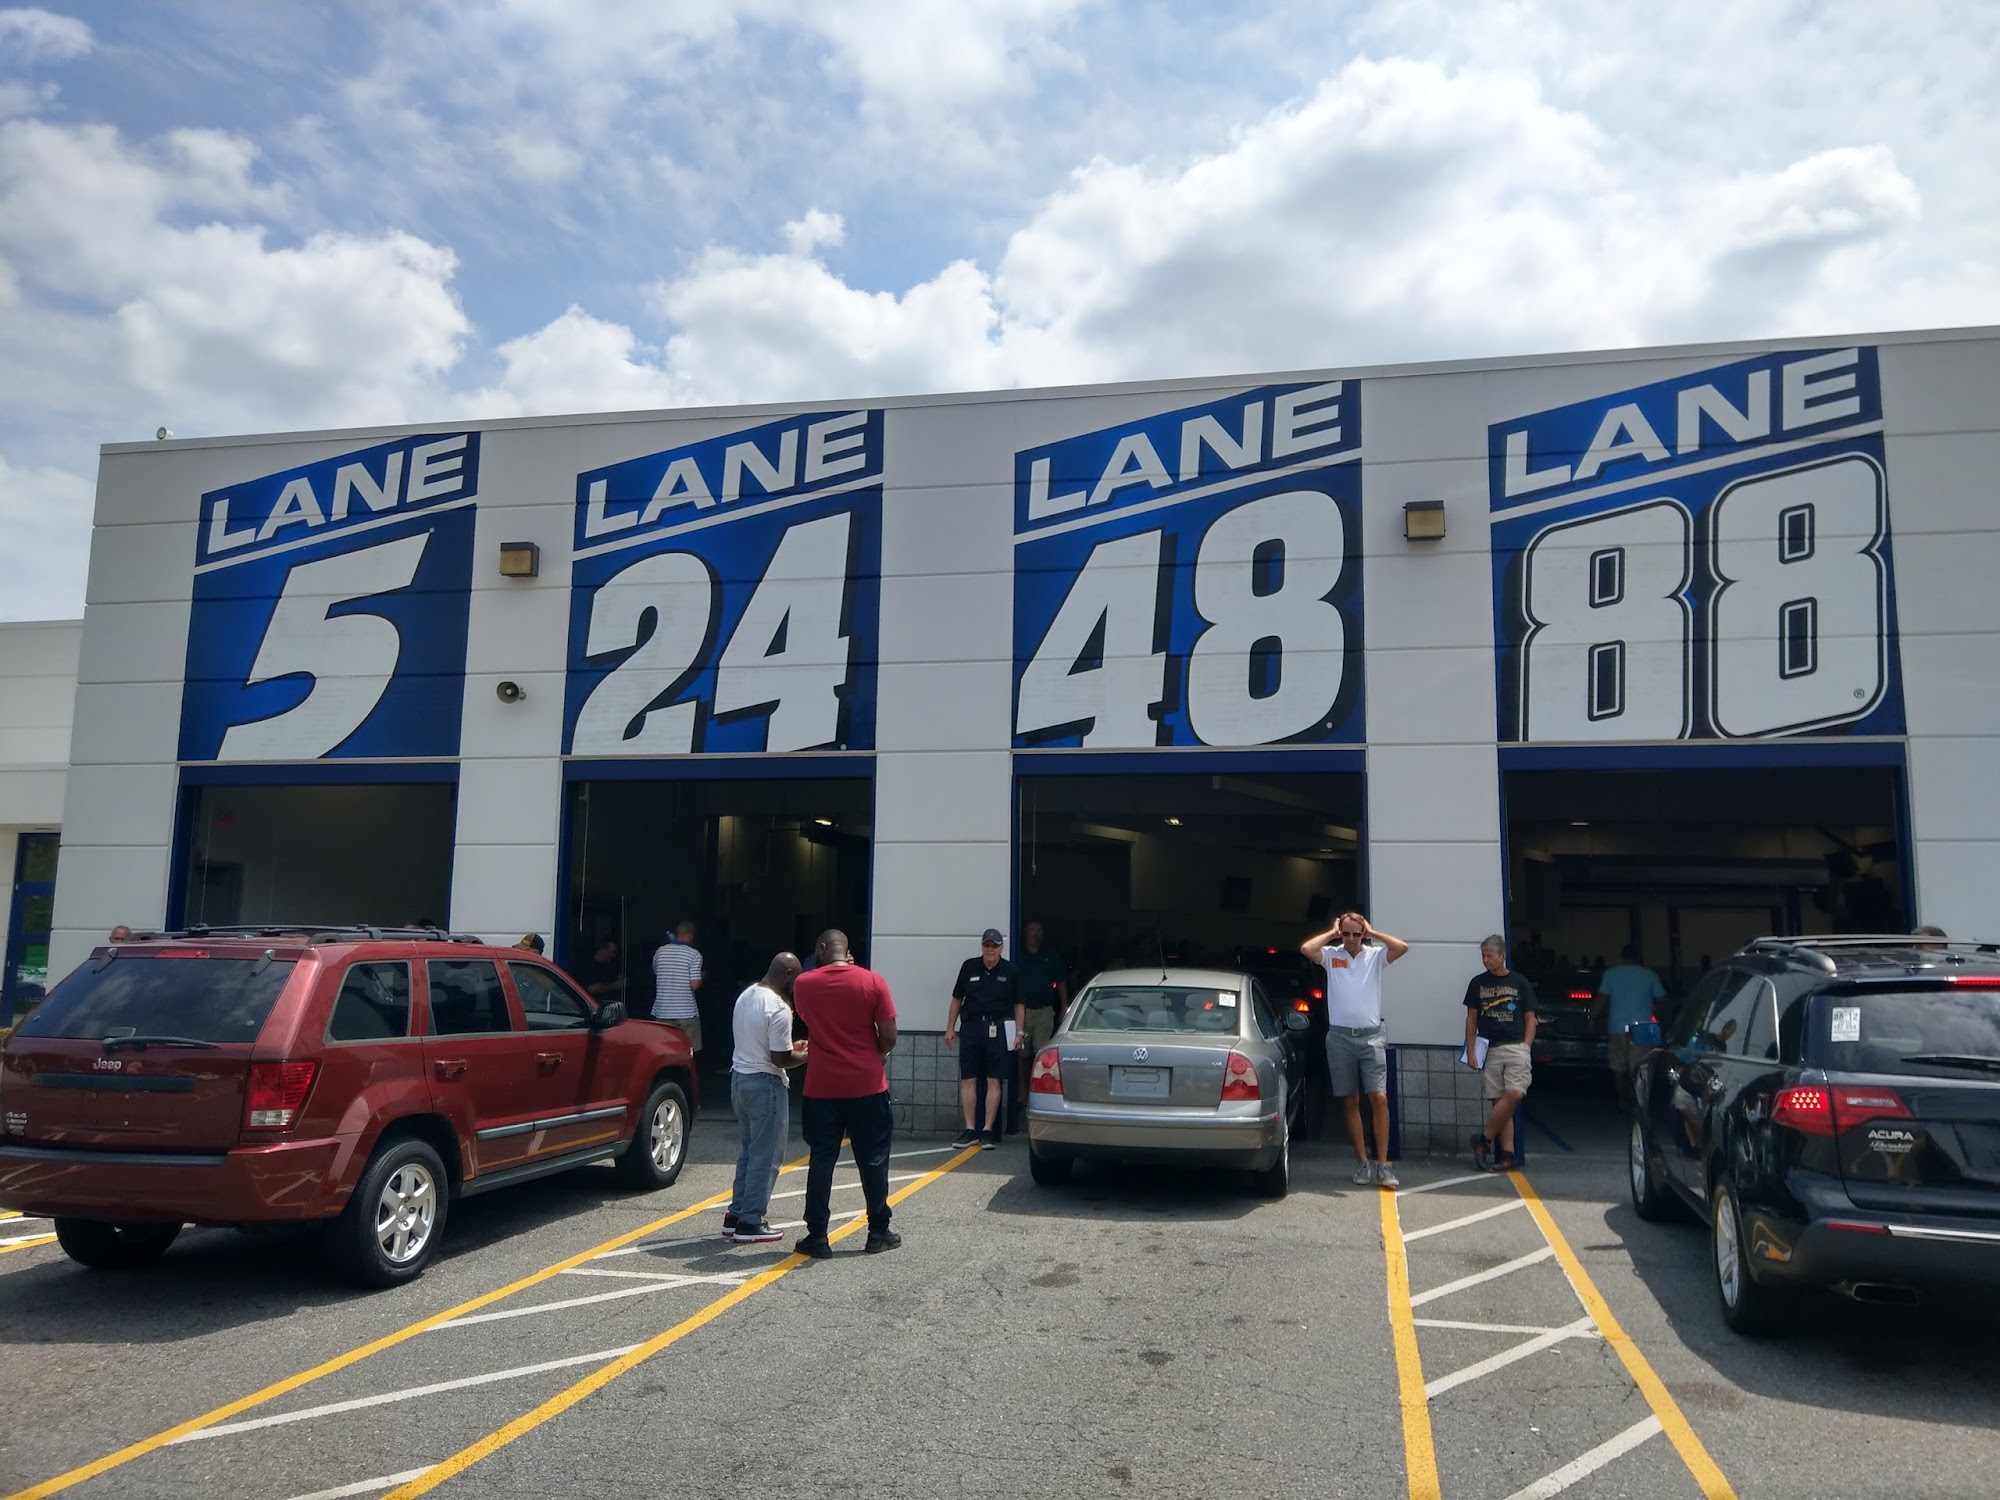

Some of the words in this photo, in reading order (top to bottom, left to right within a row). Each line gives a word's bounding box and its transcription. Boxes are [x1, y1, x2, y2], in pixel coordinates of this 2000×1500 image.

[207, 434, 468, 555] LANE
[585, 410, 868, 539] LANE
[1028, 381, 1343, 521] LANE
[1504, 347, 1860, 498] LANE
[216, 531, 431, 761] 5
[571, 511, 851, 755] 24
[1016, 490, 1345, 748] 48
[1518, 450, 1888, 742] 88
[92, 1057, 122, 1072] Jeep
[1867, 1129, 1914, 1141] ACURA
